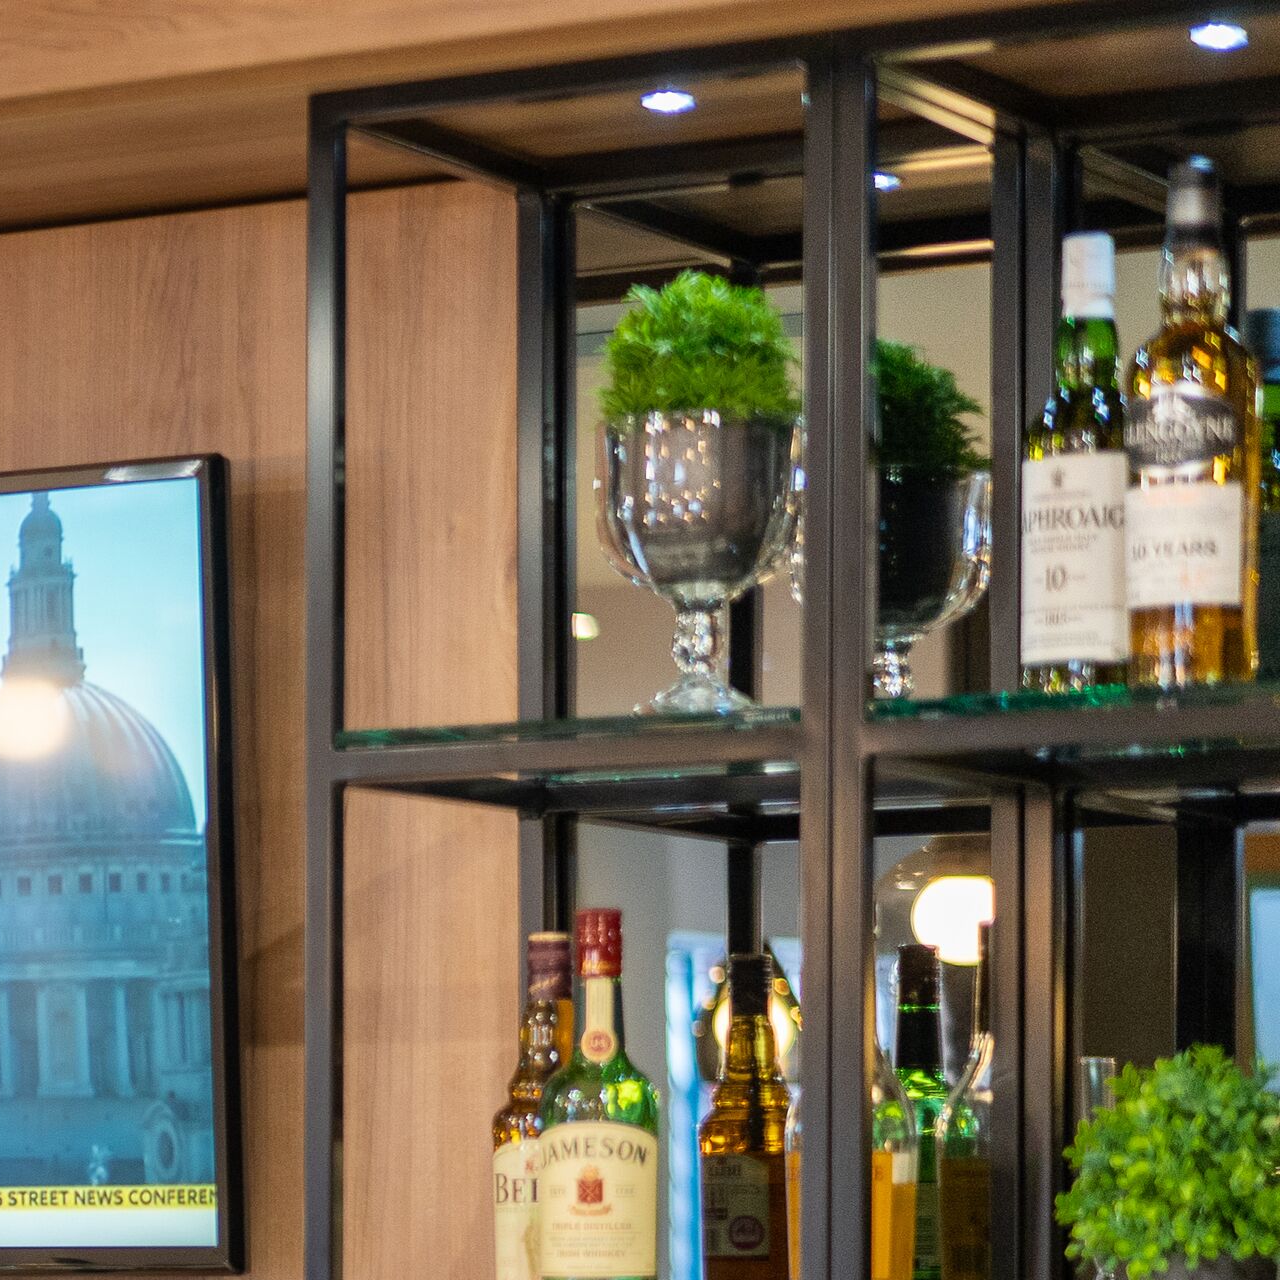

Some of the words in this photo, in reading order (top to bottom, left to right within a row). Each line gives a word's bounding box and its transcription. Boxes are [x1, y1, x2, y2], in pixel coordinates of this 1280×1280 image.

[1151, 540, 1217, 558] YEARS
[540, 1136, 648, 1170] JAMESON
[8, 1189, 68, 1207] STREET
[74, 1189, 124, 1206] NEWS
